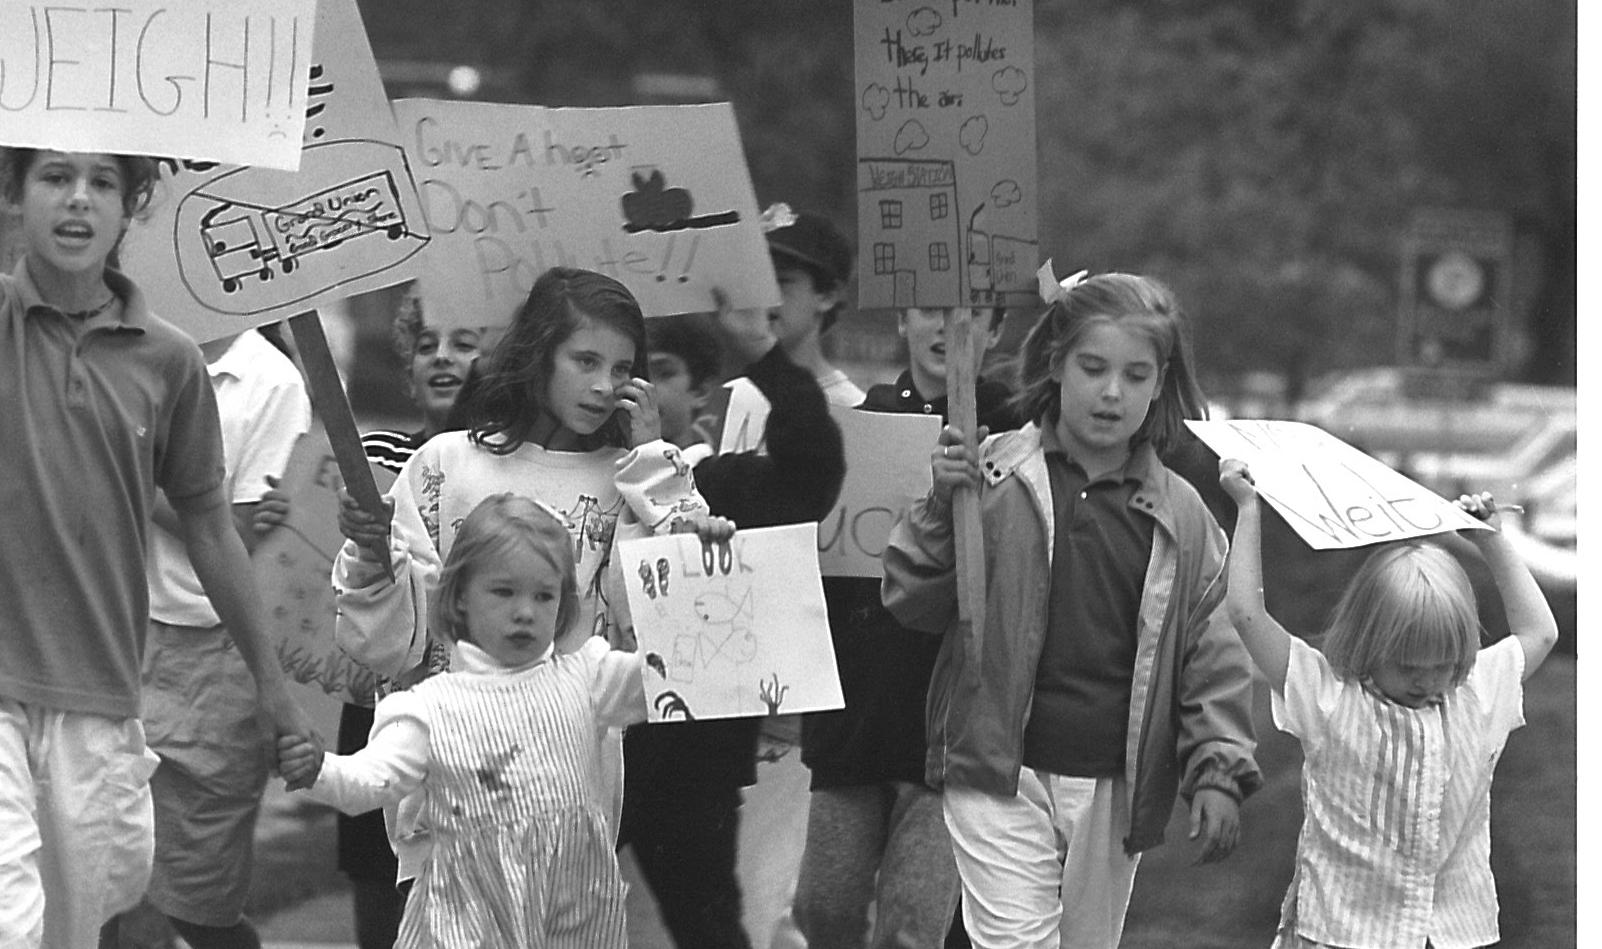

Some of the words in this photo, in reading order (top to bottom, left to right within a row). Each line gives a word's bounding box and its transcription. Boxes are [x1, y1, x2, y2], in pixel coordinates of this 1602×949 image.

[893, 75, 930, 109] the
[508, 132, 534, 166] A
[419, 178, 556, 235] Don't
[473, 234, 702, 301] Pollte!!
